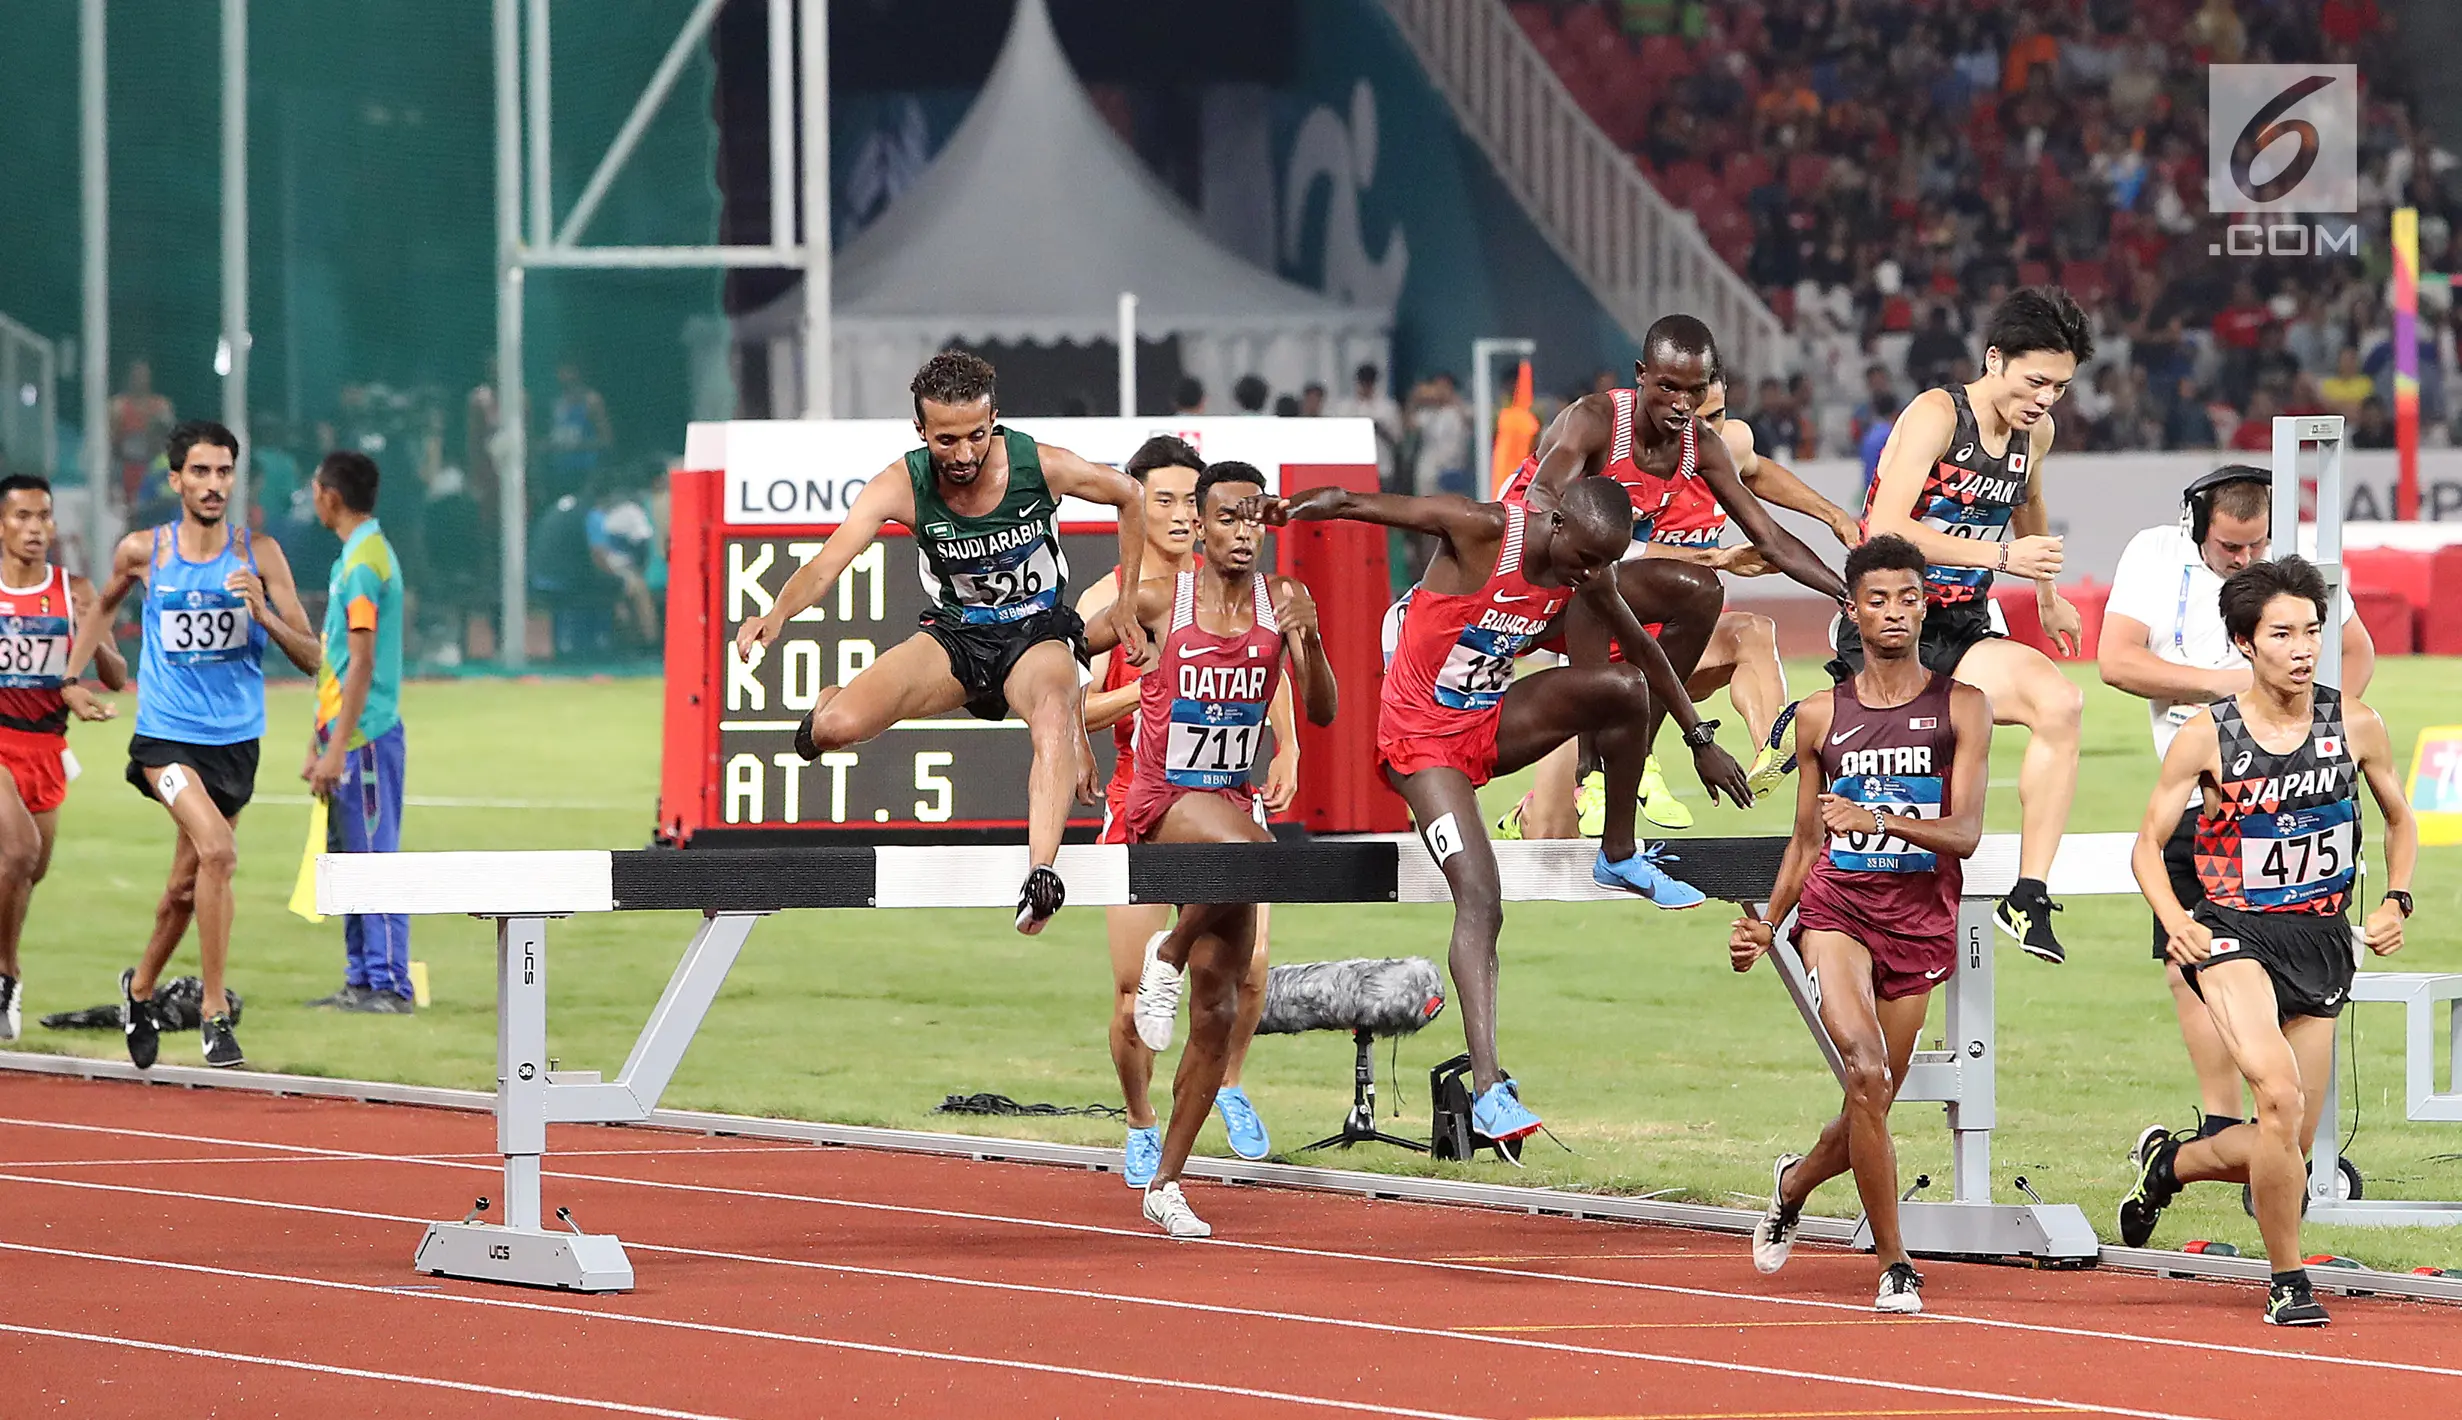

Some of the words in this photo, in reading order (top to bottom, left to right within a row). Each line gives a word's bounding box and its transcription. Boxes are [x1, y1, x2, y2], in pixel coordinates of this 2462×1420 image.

[1948, 473, 2019, 504] JAPAN
[936, 538, 987, 562] SAUDI
[989, 519, 1044, 556] ARABIA
[1653, 524, 1725, 544] IRAN
[971, 560, 1042, 606] 526
[176, 611, 235, 648] 339
[0, 638, 53, 673] 387
[1179, 664, 1267, 700] QATAR
[1186, 726, 1250, 769] 711
[1841, 746, 1932, 778] QATAR
[1212, 774, 1232, 785] BNI
[2243, 767, 2338, 807] JAPAN
[1435, 824, 1448, 853] 6
[2261, 828, 2339, 885] 475
[1878, 857, 1899, 869] BNI
[524, 941, 534, 985] UCS
[1970, 926, 1980, 969] UCS
[489, 1244, 510, 1260] UCS
